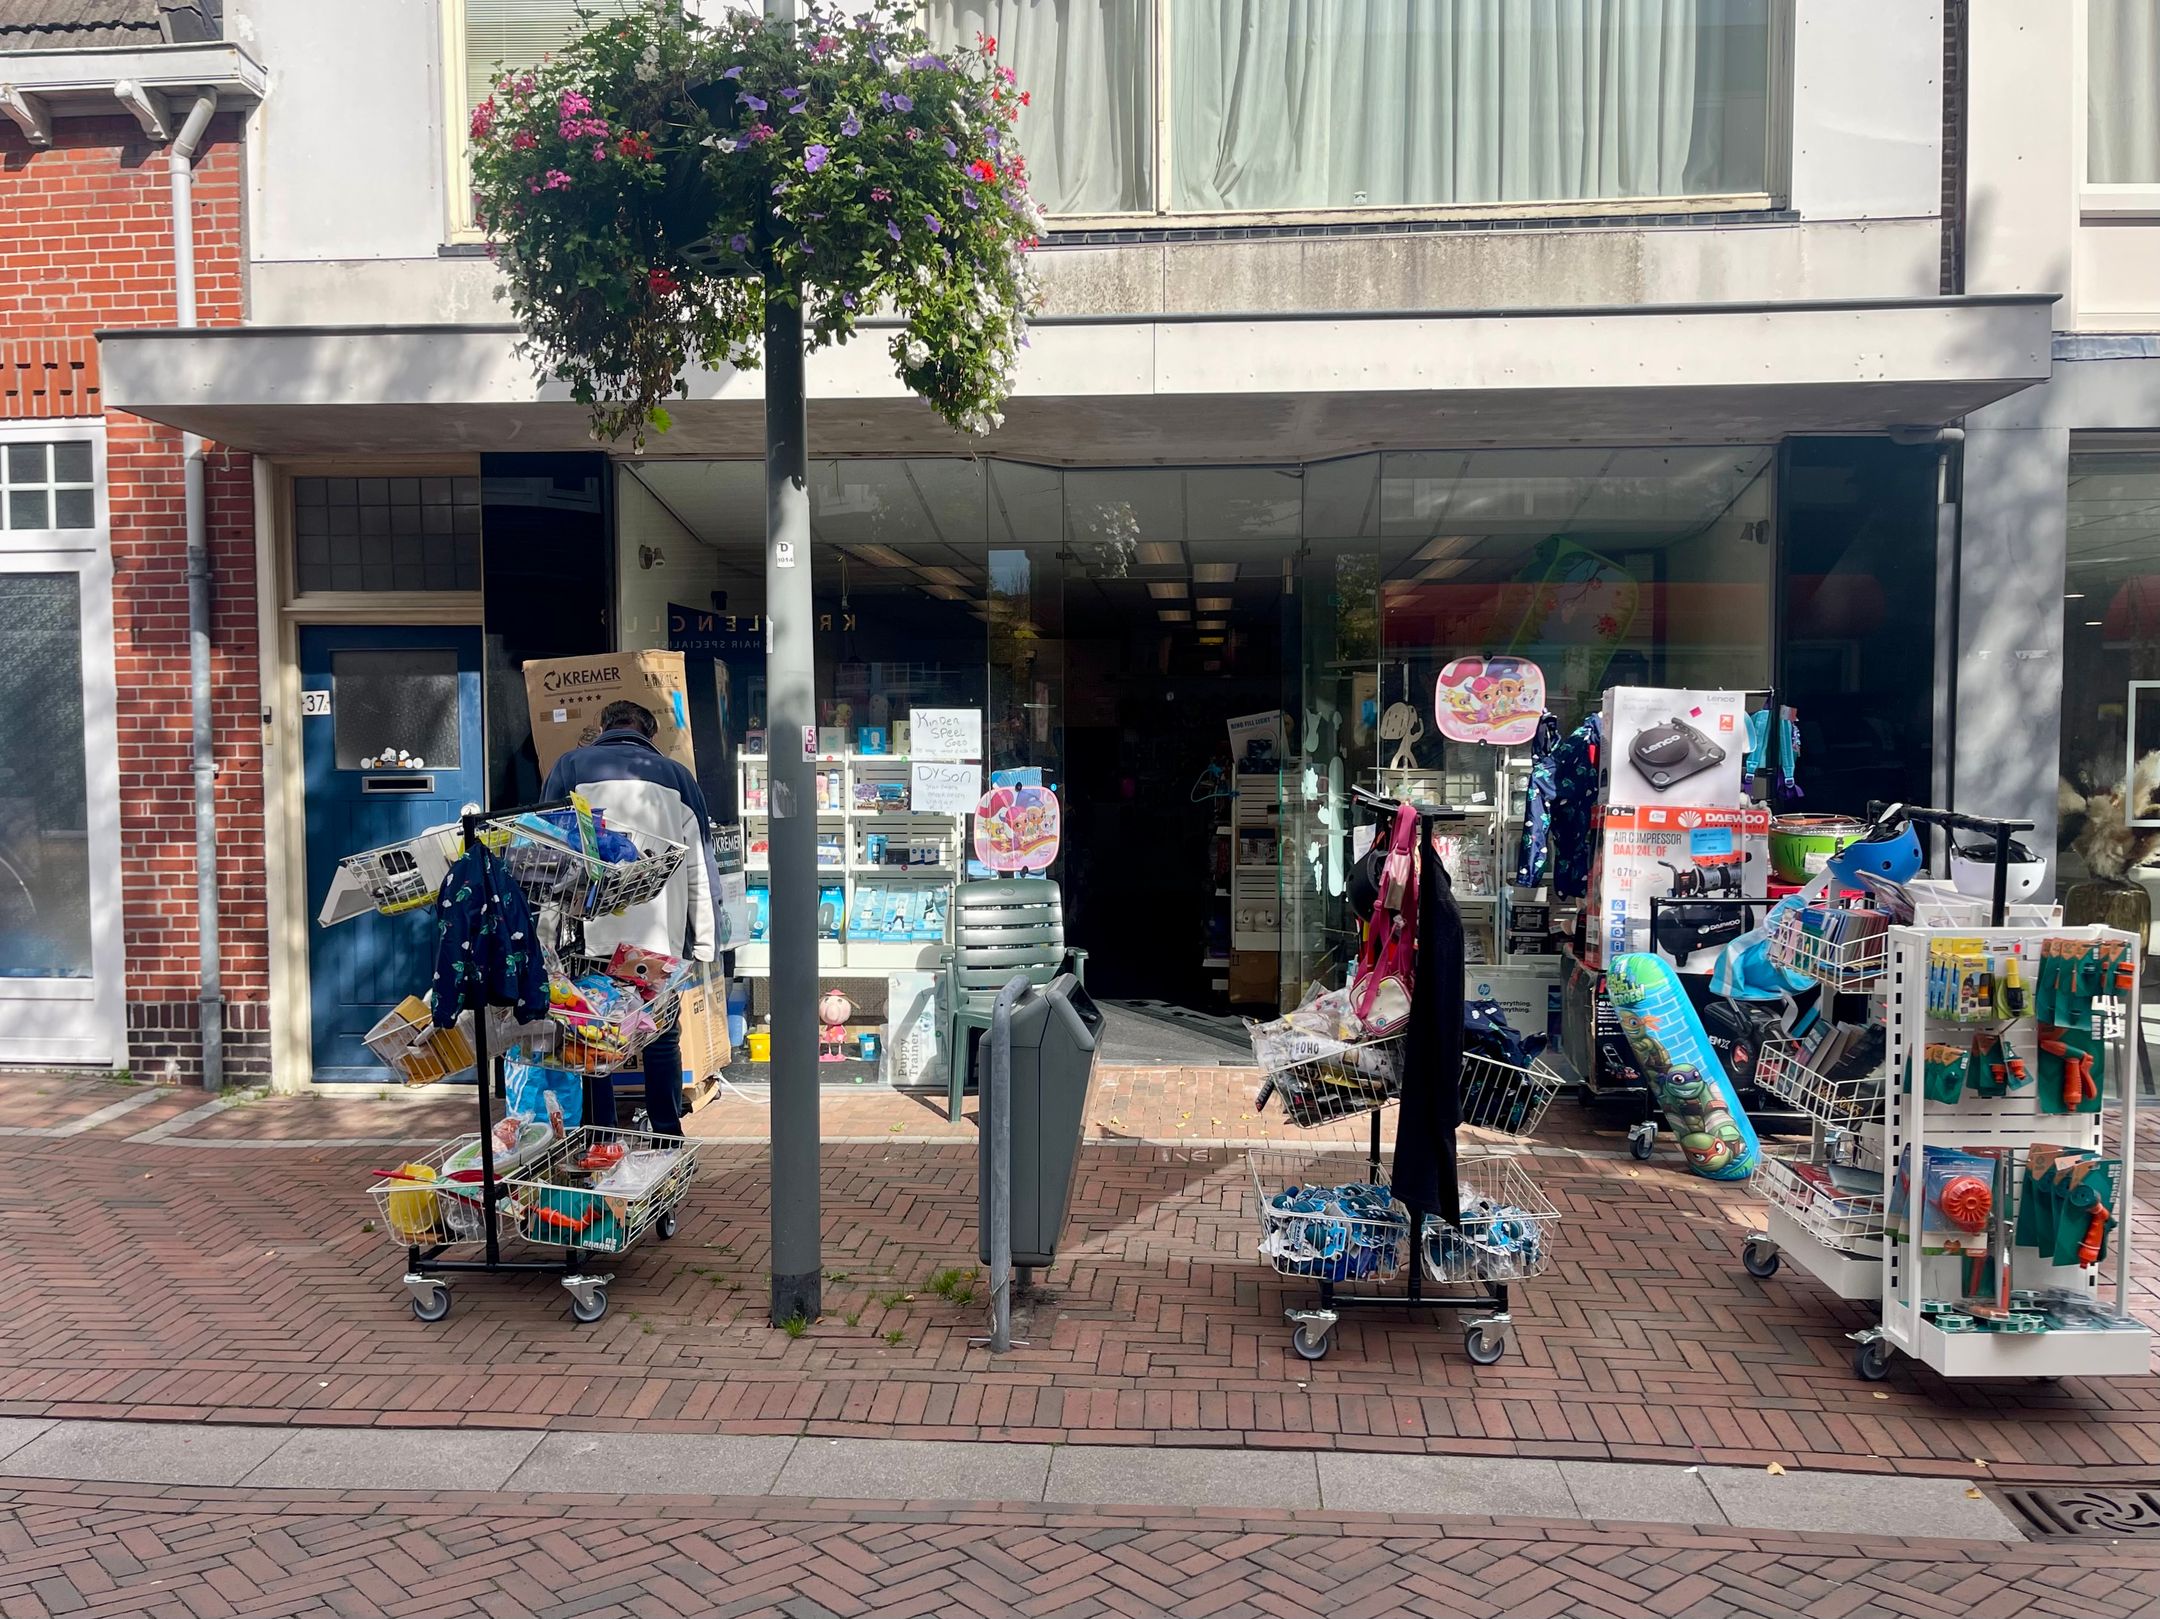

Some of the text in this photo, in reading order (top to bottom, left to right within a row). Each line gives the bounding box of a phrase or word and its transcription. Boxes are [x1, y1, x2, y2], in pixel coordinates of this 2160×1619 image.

[563, 667, 621, 686] KREMER
[1706, 695, 1736, 703] Lenco
[1641, 734, 1681, 754] Lenco
[1705, 813, 1765, 824] DAEWOO
[1613, 832, 1627, 843] AIR
[1709, 919, 1741, 931] DAEWOO
[898, 1038, 910, 1076] Puppy
[909, 1032, 919, 1076] Trainer
